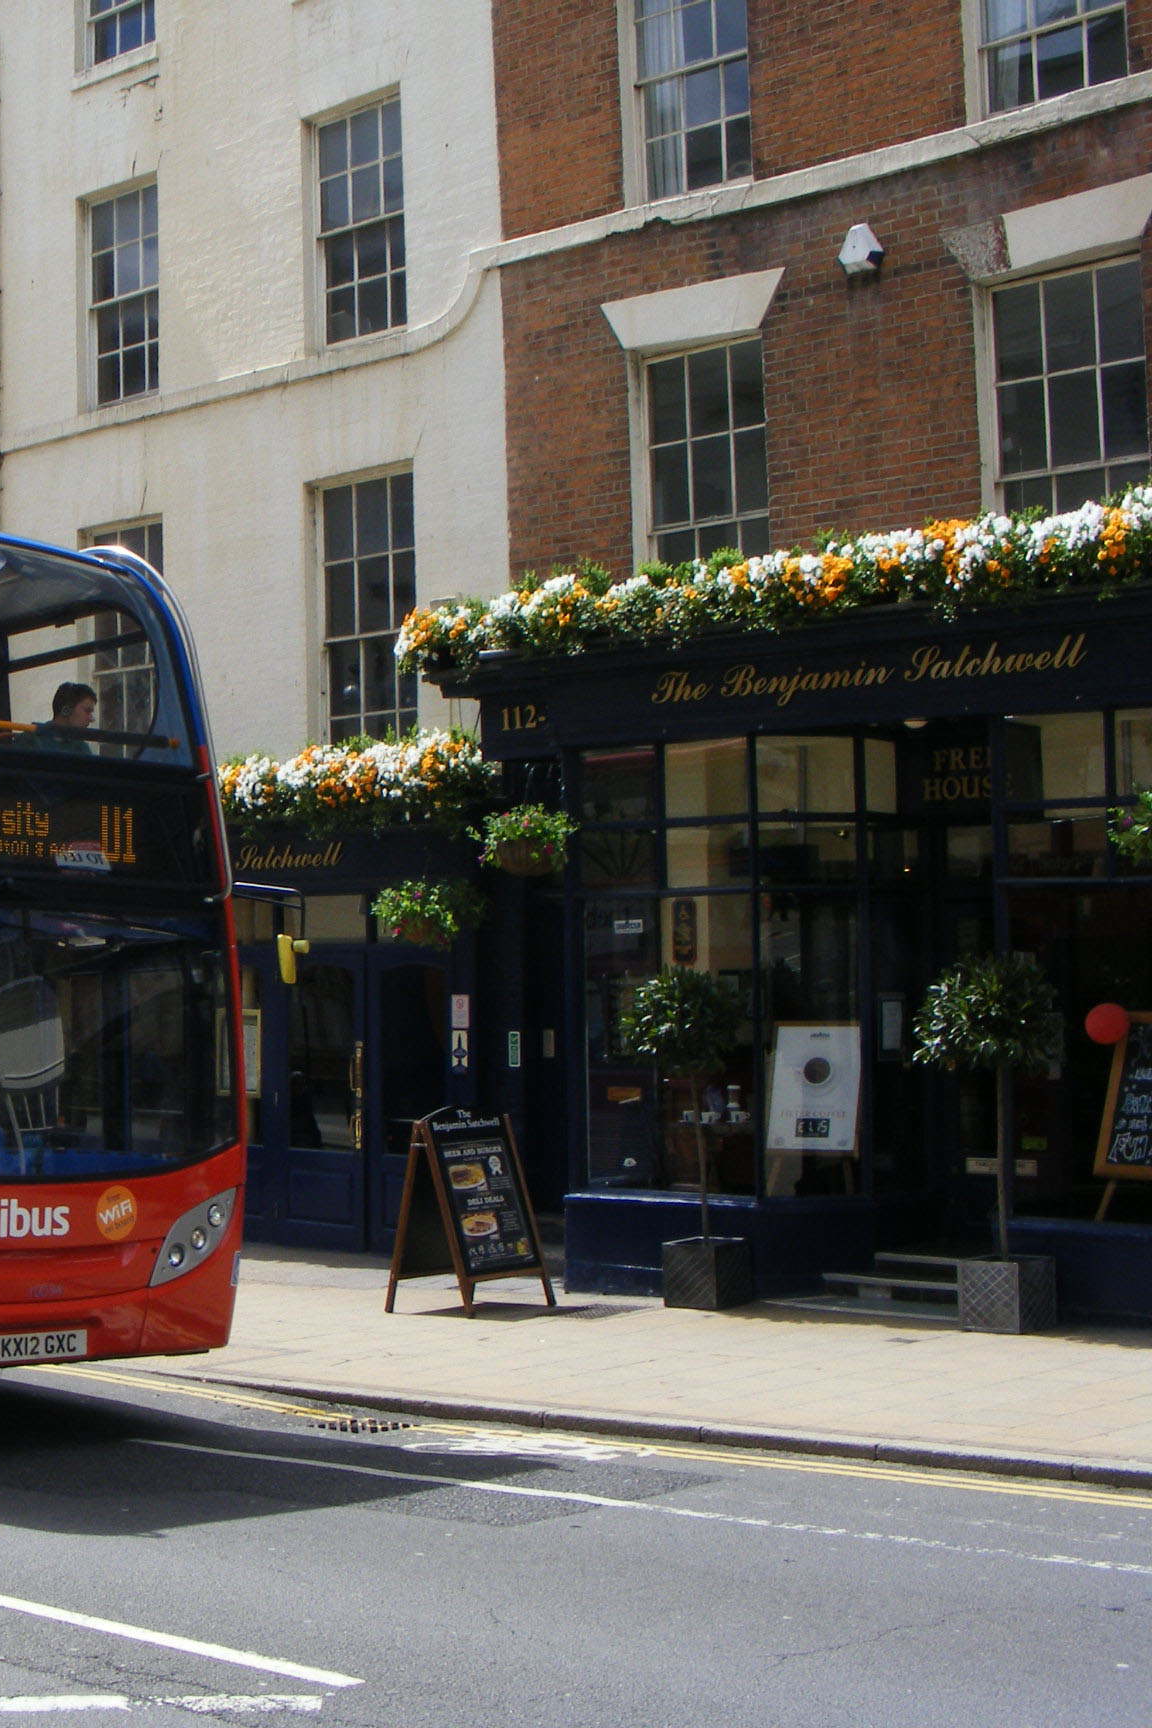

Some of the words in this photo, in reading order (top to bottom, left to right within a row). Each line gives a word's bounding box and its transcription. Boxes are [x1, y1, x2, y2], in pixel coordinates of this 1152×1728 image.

[651, 671, 711, 704] The
[720, 664, 895, 707] Benjamin
[903, 633, 1089, 681] Satchwell
[101, 805, 136, 864] U1
[234, 841, 344, 871] Satchwell
[432, 1119, 467, 1133] Benjamin
[467, 1117, 500, 1130] Satchwell
[456, 1109, 472, 1119] The
[98, 1199, 133, 1225] WiFi
[1, 1336, 40, 1358] KX12
[44, 1333, 77, 1355] GXC
